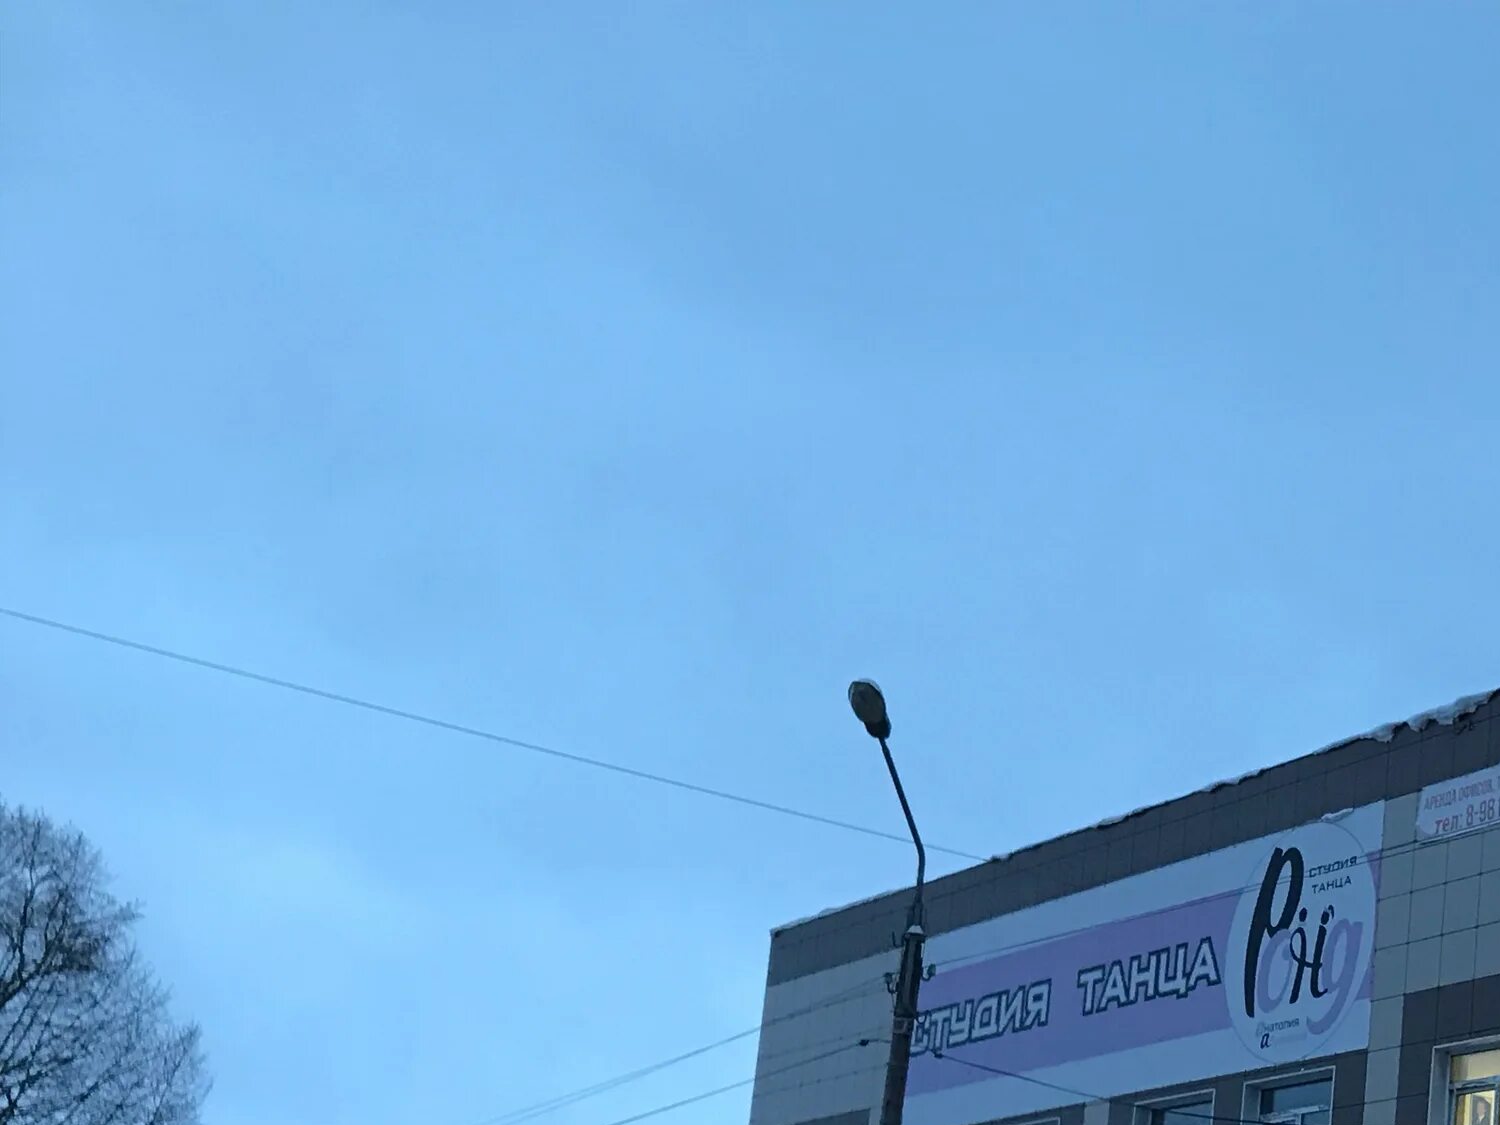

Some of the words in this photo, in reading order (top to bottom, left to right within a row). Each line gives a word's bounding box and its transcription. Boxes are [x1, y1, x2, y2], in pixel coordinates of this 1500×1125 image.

[1424, 788, 1456, 810] АРЕНДА
[1309, 855, 1357, 878] СТУДИЯ
[1312, 875, 1352, 894] ТАНЦА
[910, 978, 1052, 1056] СТУДИЯ
[1077, 937, 1221, 1017] ТАНЦА
